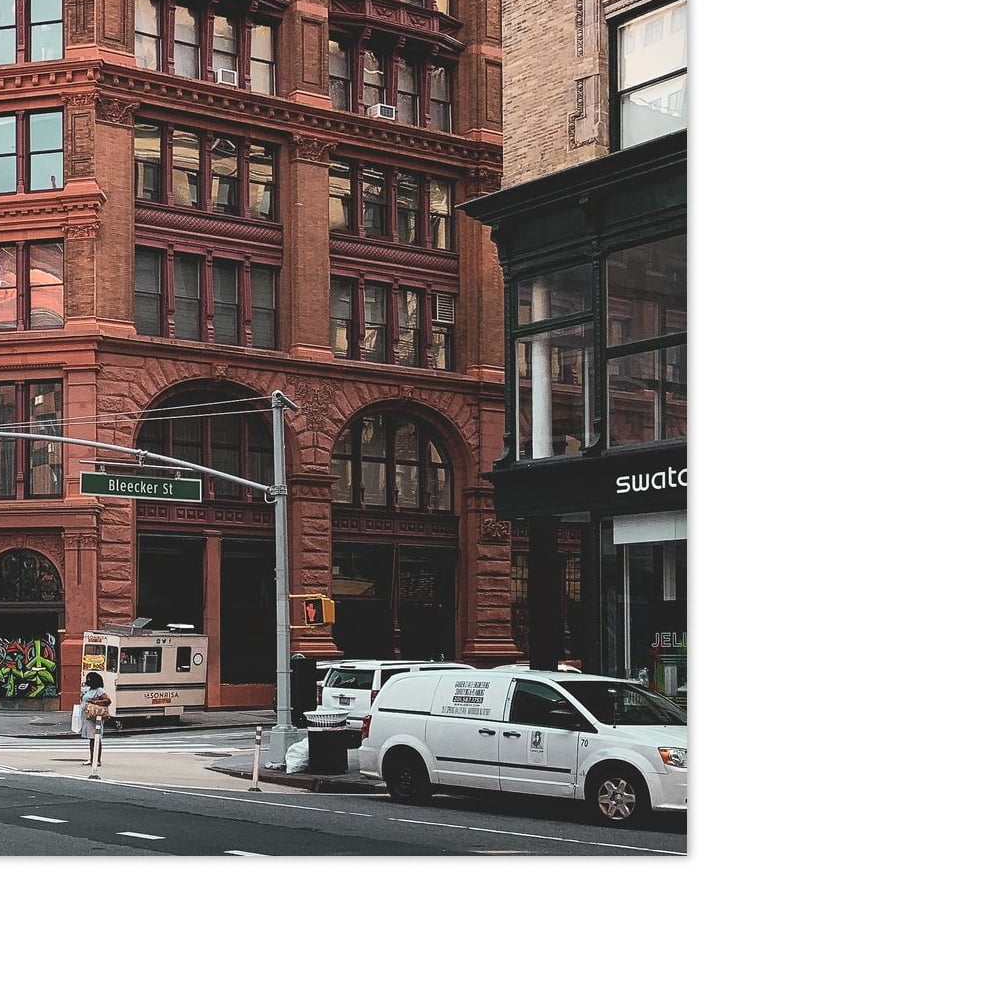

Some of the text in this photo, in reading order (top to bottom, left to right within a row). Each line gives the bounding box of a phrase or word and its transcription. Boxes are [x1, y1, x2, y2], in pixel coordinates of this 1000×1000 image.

[108, 479, 173, 495] Bleecker St
[581, 739, 588, 747] 70
